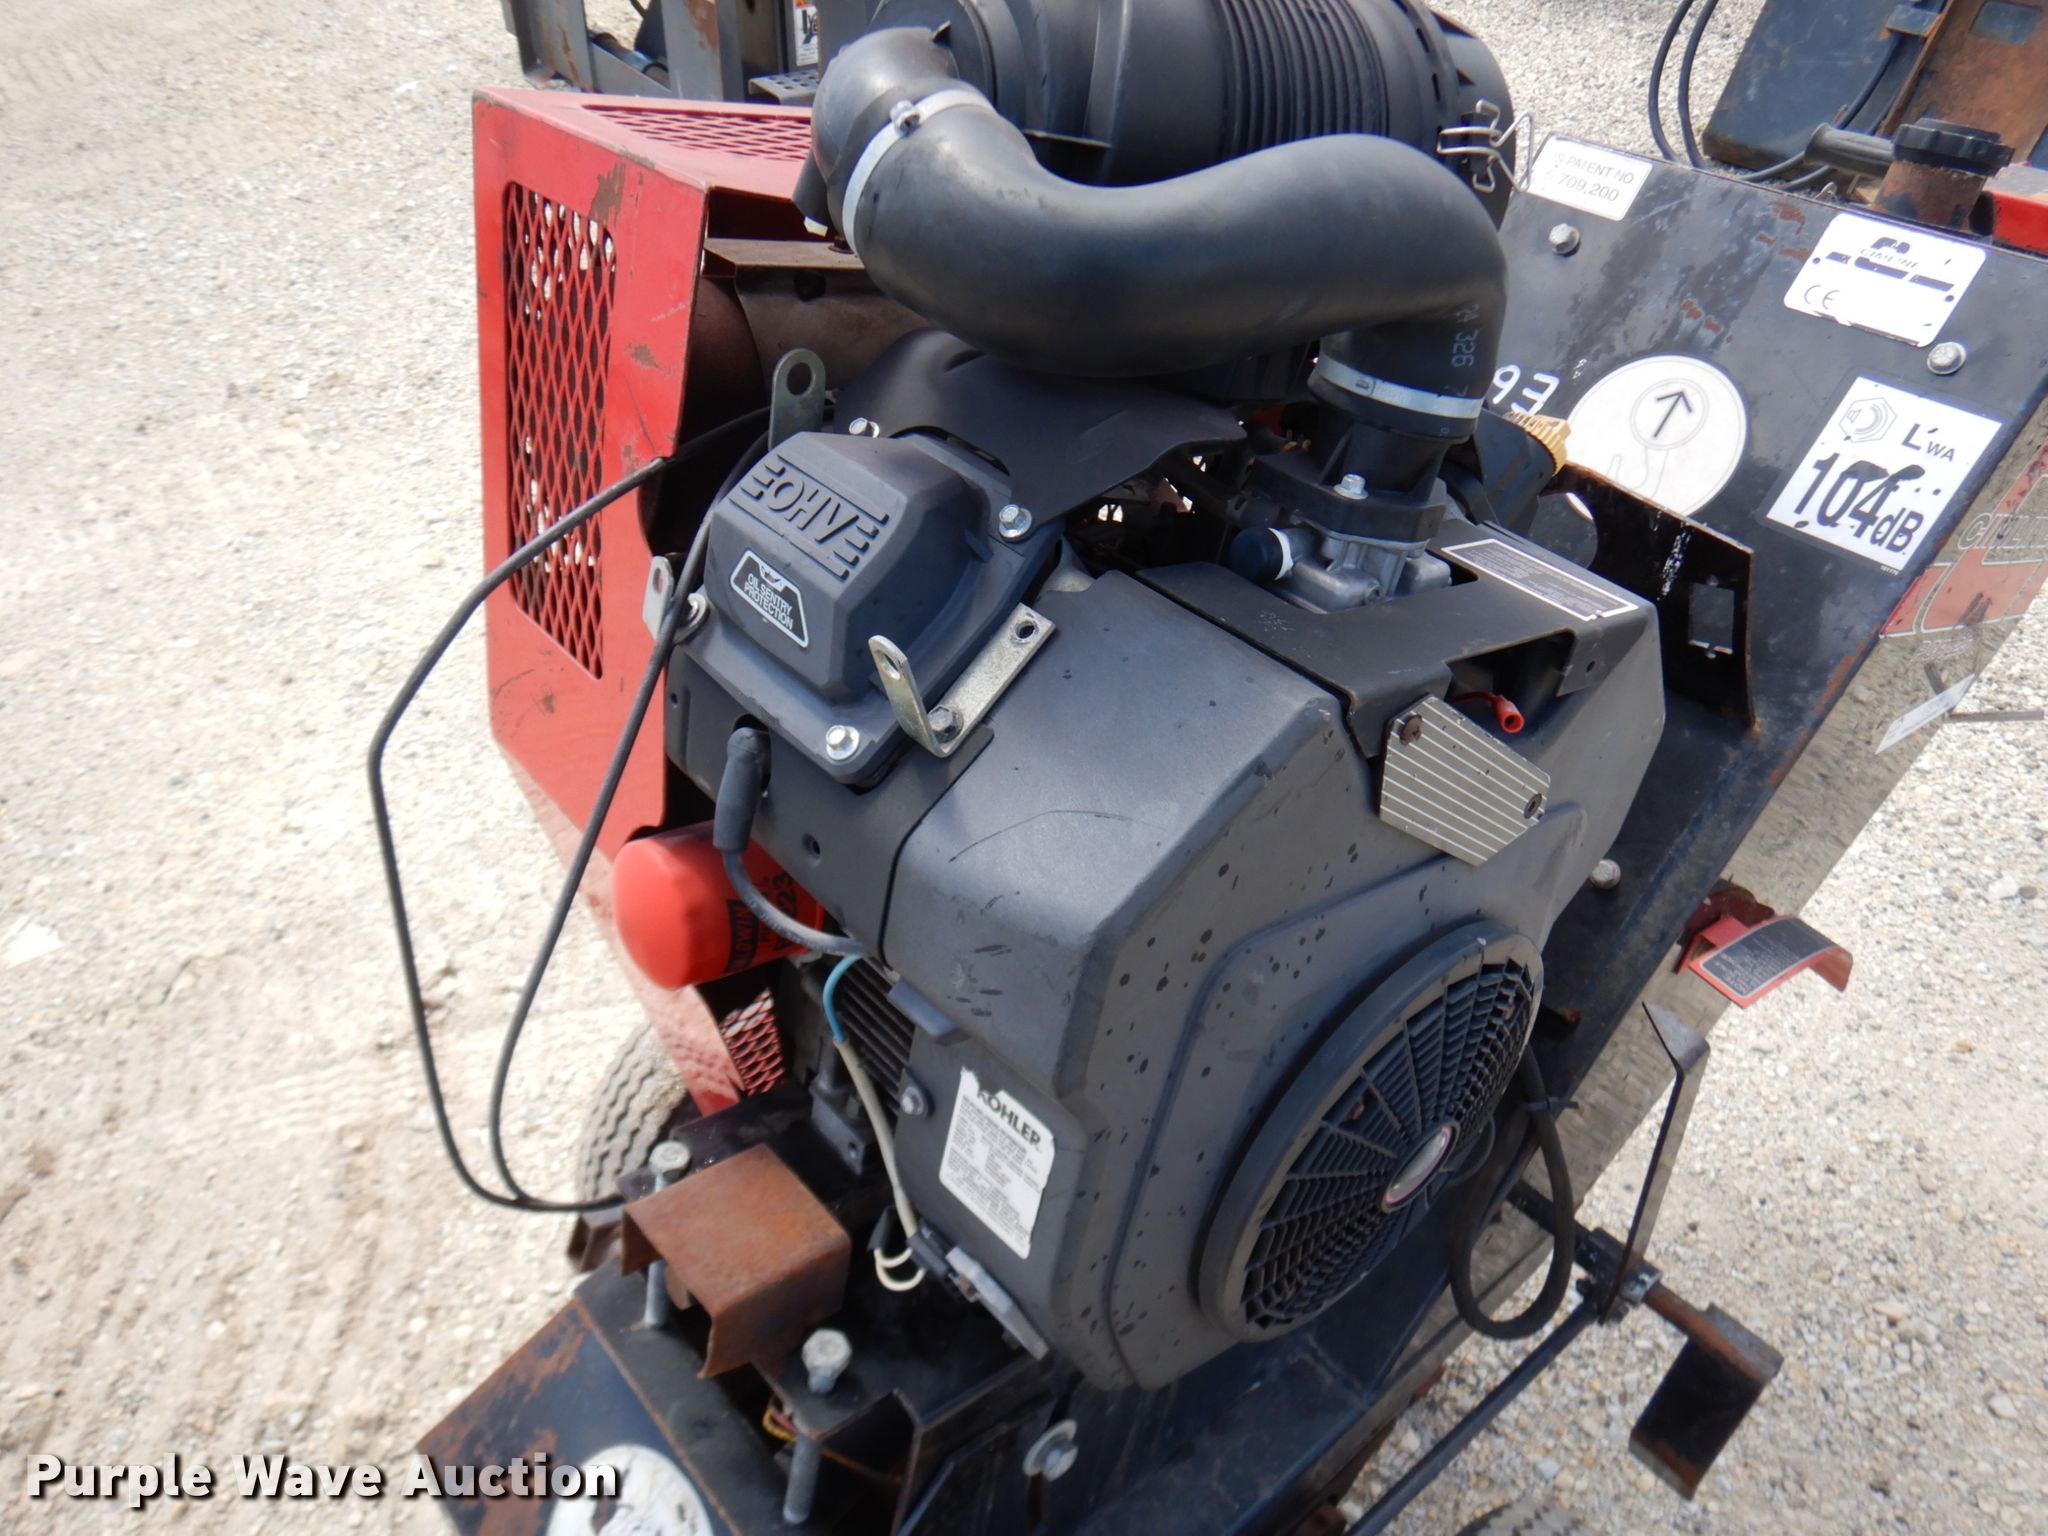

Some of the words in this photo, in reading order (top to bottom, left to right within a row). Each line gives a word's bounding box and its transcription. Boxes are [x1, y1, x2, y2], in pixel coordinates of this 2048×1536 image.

[1859, 248, 1920, 271] CIMLNE
[743, 580, 794, 630] PROTECTION
[747, 572, 761, 593] OIL
[759, 583, 793, 616] SENTRY
